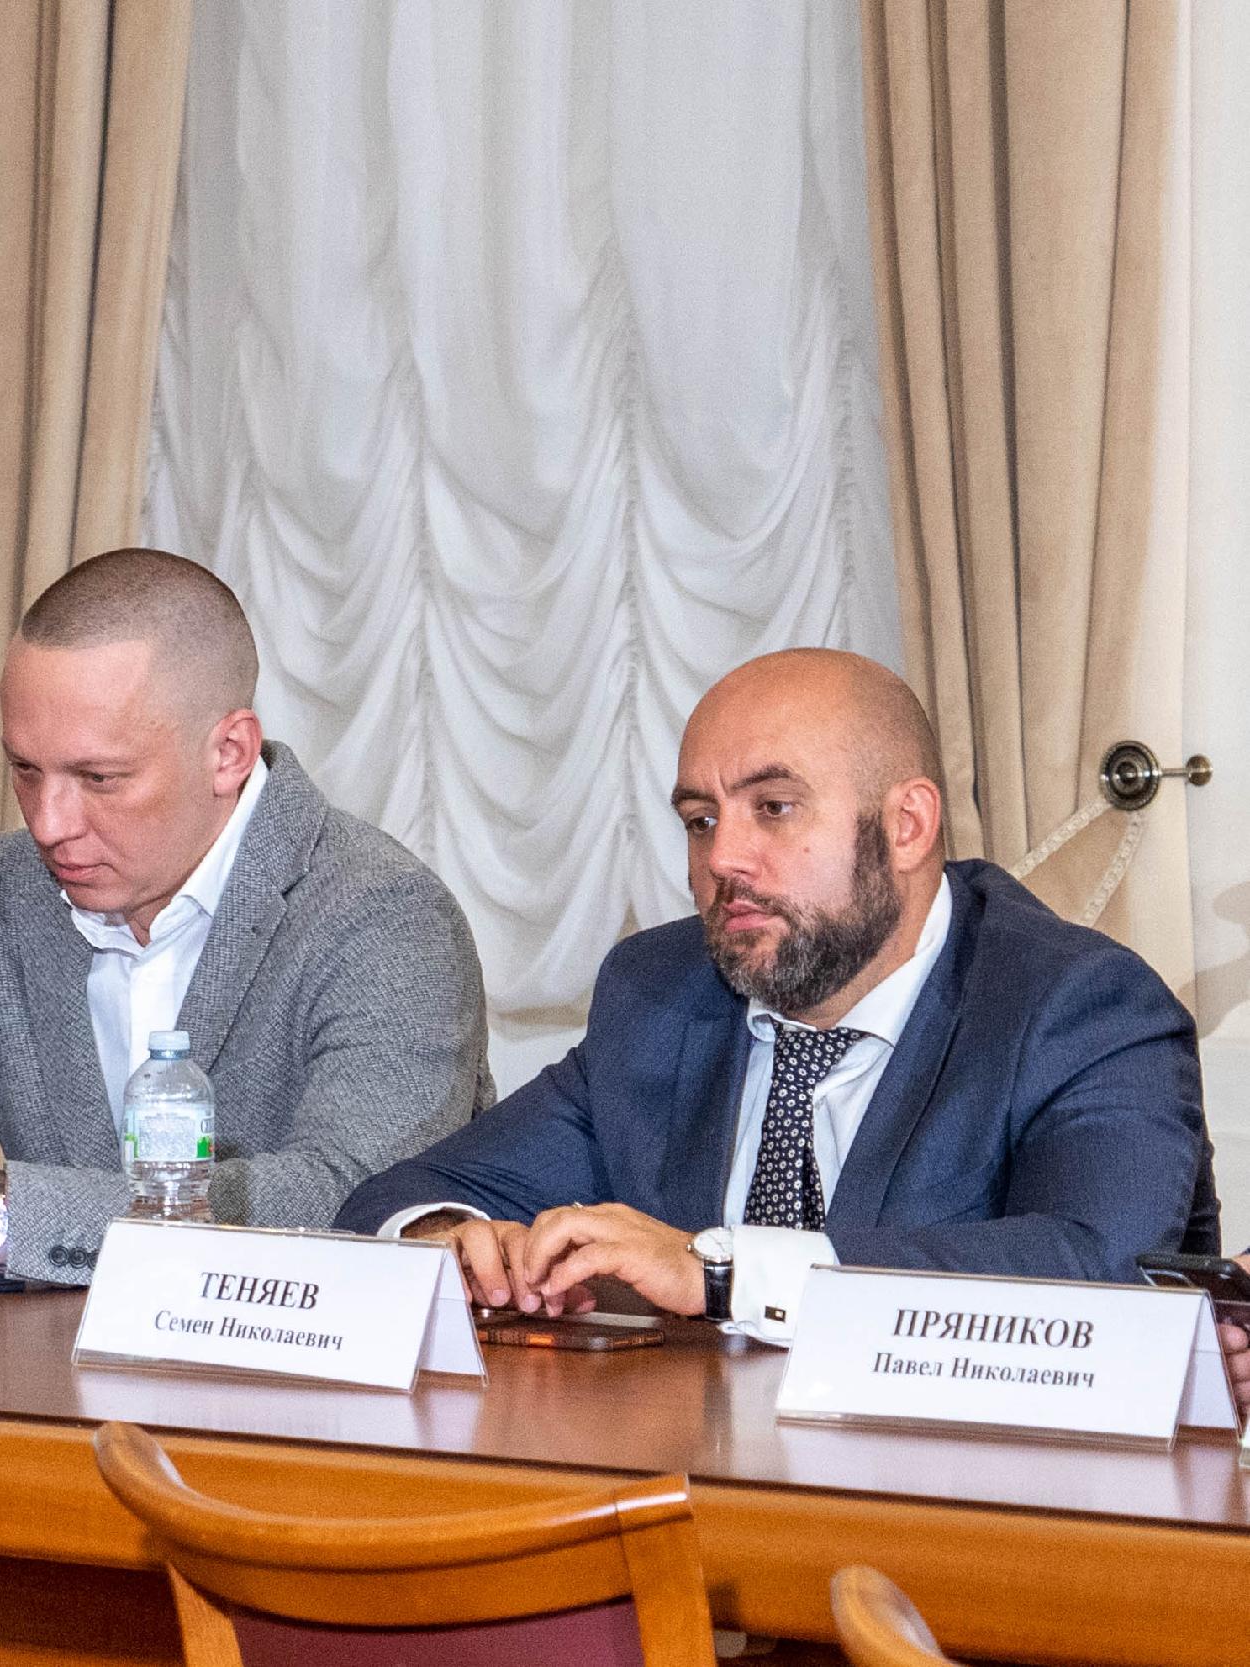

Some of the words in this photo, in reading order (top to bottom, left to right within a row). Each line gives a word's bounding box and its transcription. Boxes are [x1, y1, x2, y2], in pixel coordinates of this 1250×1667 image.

[200, 1271, 321, 1311] ТЕНЯЕВ
[154, 1310, 214, 1335] Семен
[218, 1316, 344, 1351] Николаевич
[892, 1308, 1095, 1350] ПРЯНИКОВ
[871, 1352, 943, 1377] Павел
[950, 1356, 1095, 1388] Николаевич
